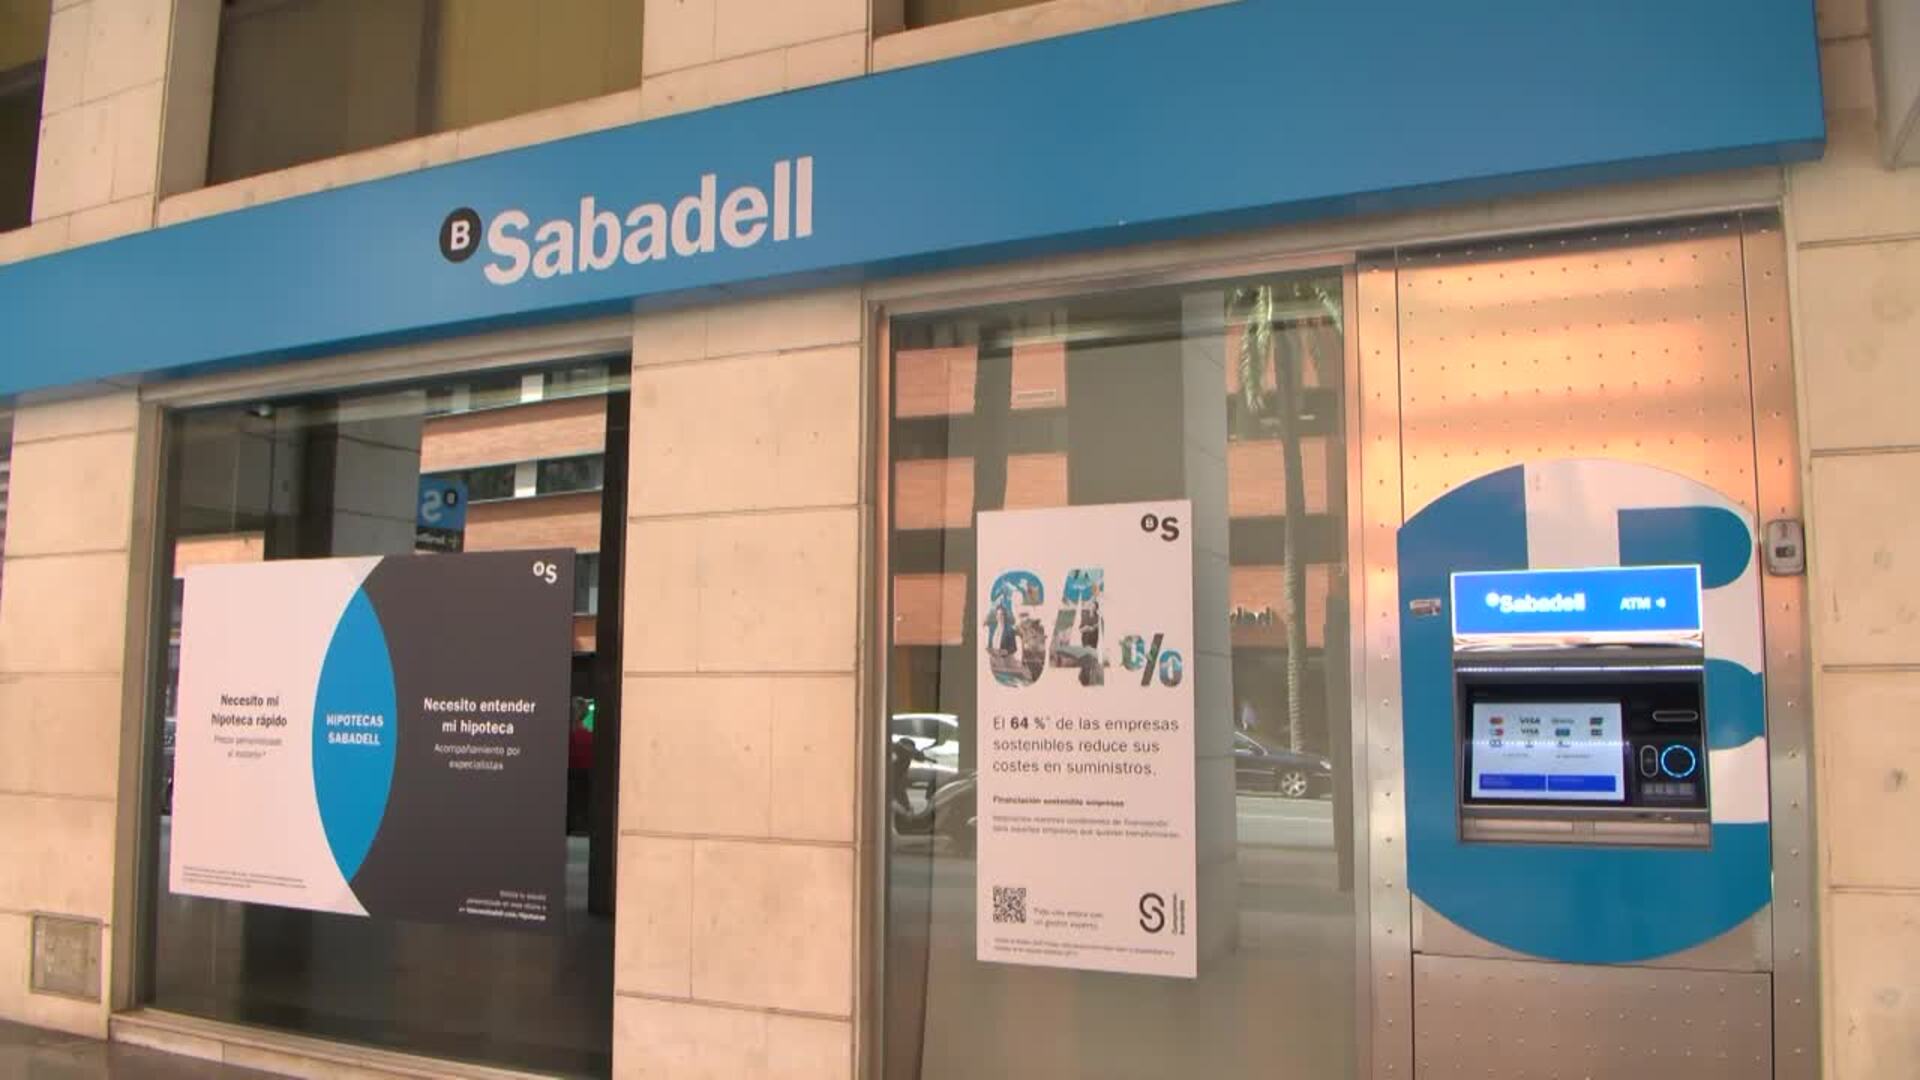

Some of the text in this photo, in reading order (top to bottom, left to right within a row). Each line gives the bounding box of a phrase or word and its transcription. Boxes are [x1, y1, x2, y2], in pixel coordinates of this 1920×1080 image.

[483, 156, 813, 285] Sabadell
[1500, 592, 1586, 613] Sabadell
[1620, 597, 1651, 610] ATM
[220, 694, 279, 706] Necesito mi
[424, 697, 536, 713] Necesito entender
[211, 713, 287, 727] hipoteca rápido
[326, 714, 384, 727] HIPOTECAS
[442, 720, 514, 735] mi hipoteca
[993, 716, 1005, 730] El
[1010, 716, 1029, 730] 64
[1056, 717, 1073, 730] de
[1079, 717, 1100, 730] las
[1105, 719, 1179, 733] empresas
[328, 732, 381, 745] SABADELL
[993, 739, 1160, 753] sostenibles reduce sus
[993, 760, 1157, 776] costes en suministros.
